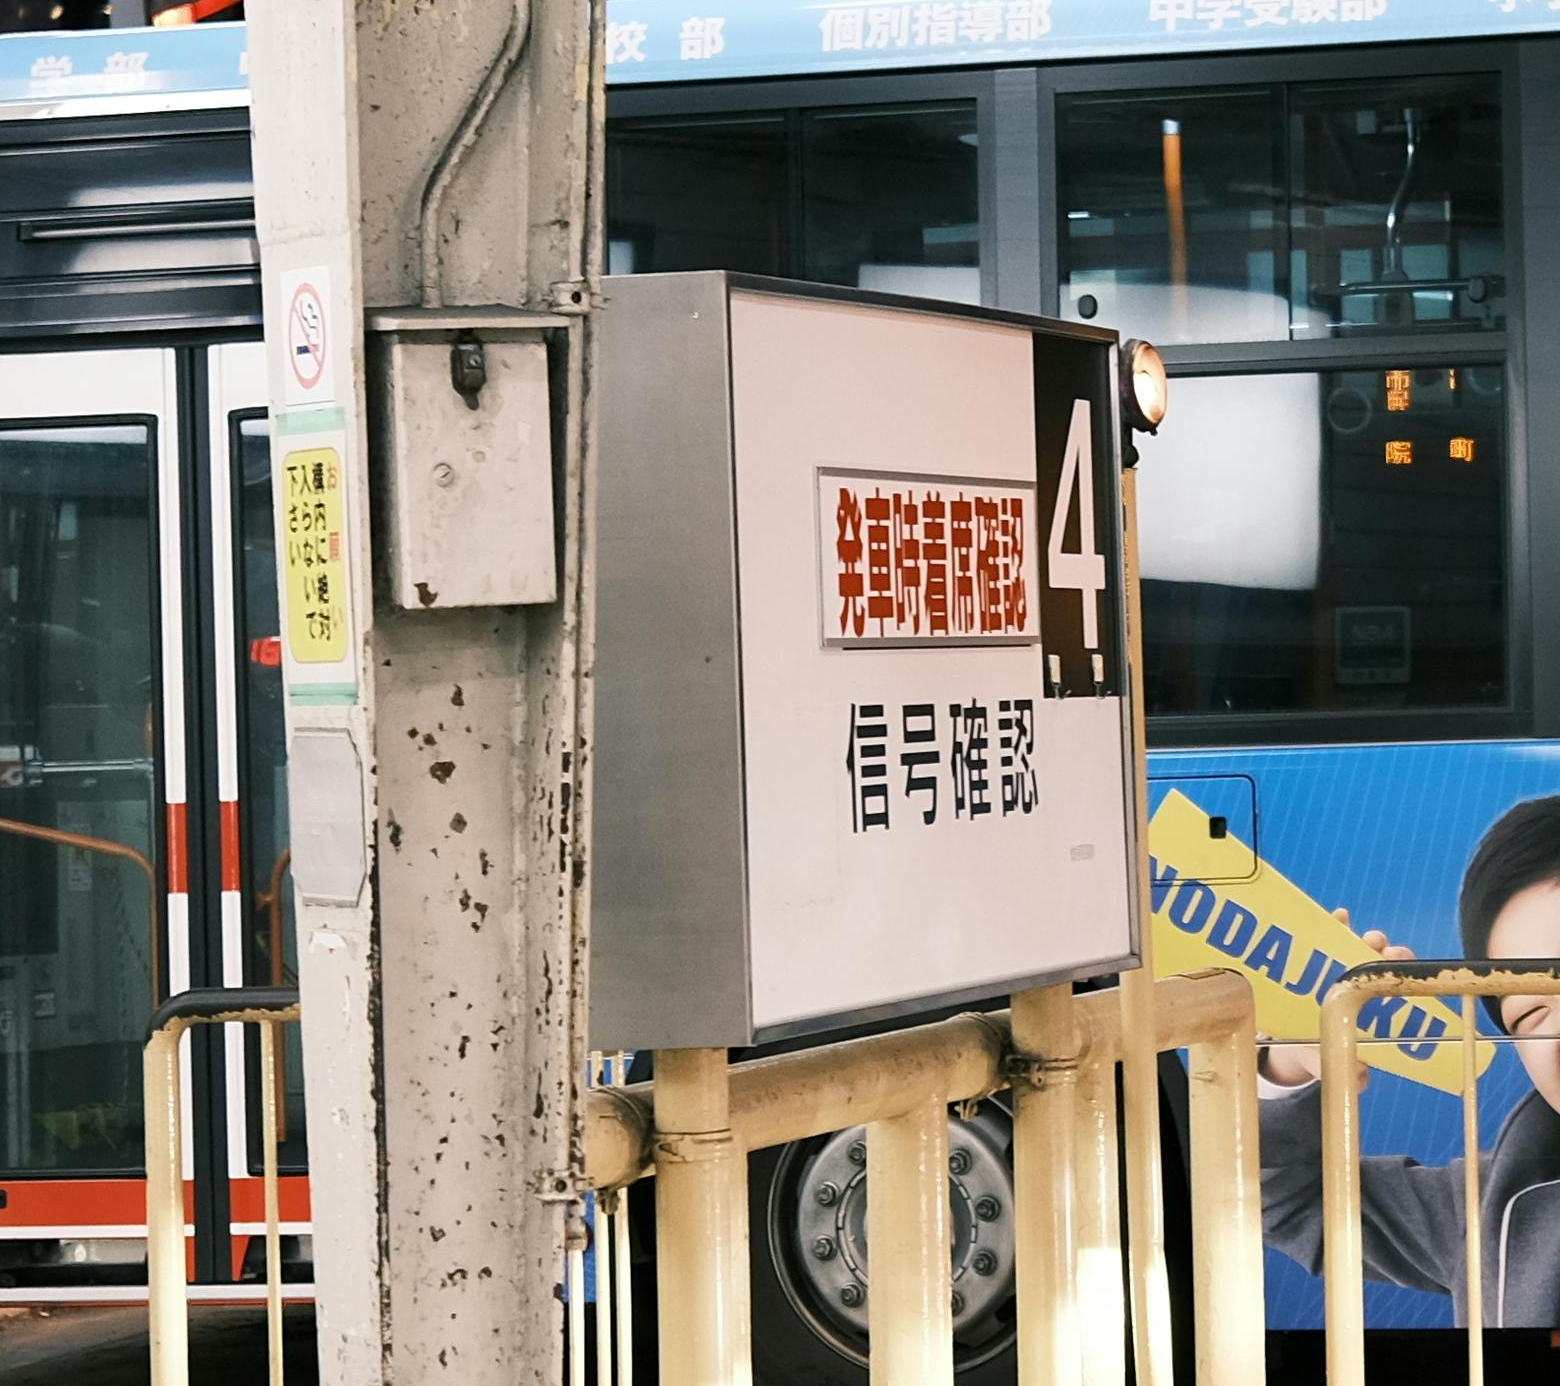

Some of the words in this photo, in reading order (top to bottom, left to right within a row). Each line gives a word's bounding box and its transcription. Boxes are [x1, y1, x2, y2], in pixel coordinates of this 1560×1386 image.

[836, 487, 1028, 638] 発車時着席確認
[1048, 398, 1106, 649] 4
[846, 698, 1039, 833] 信号確認
